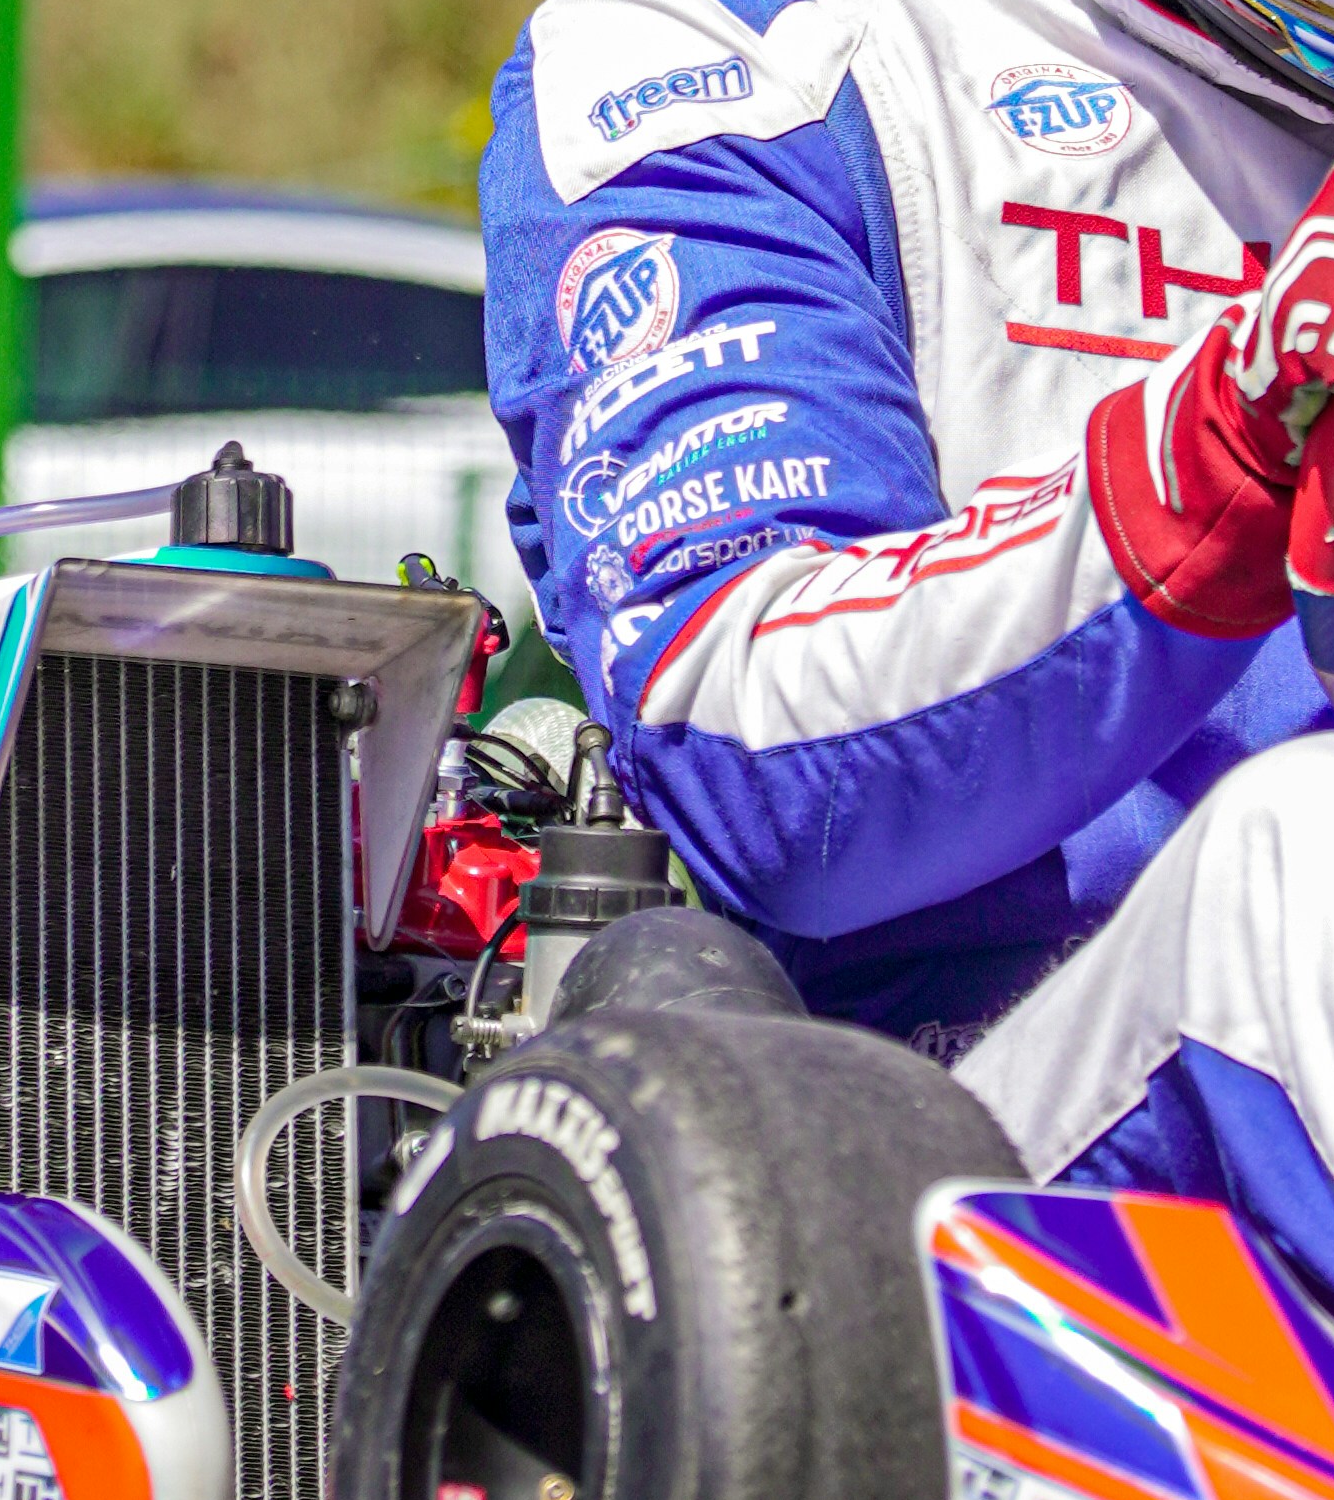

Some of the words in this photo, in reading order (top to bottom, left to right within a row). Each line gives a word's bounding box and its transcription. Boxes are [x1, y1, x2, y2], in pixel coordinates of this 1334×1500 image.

[593, 60, 748, 136] freem
[602, 402, 788, 514] VENATOR
[618, 471, 730, 546] CORSE
[735, 456, 830, 503] KART
